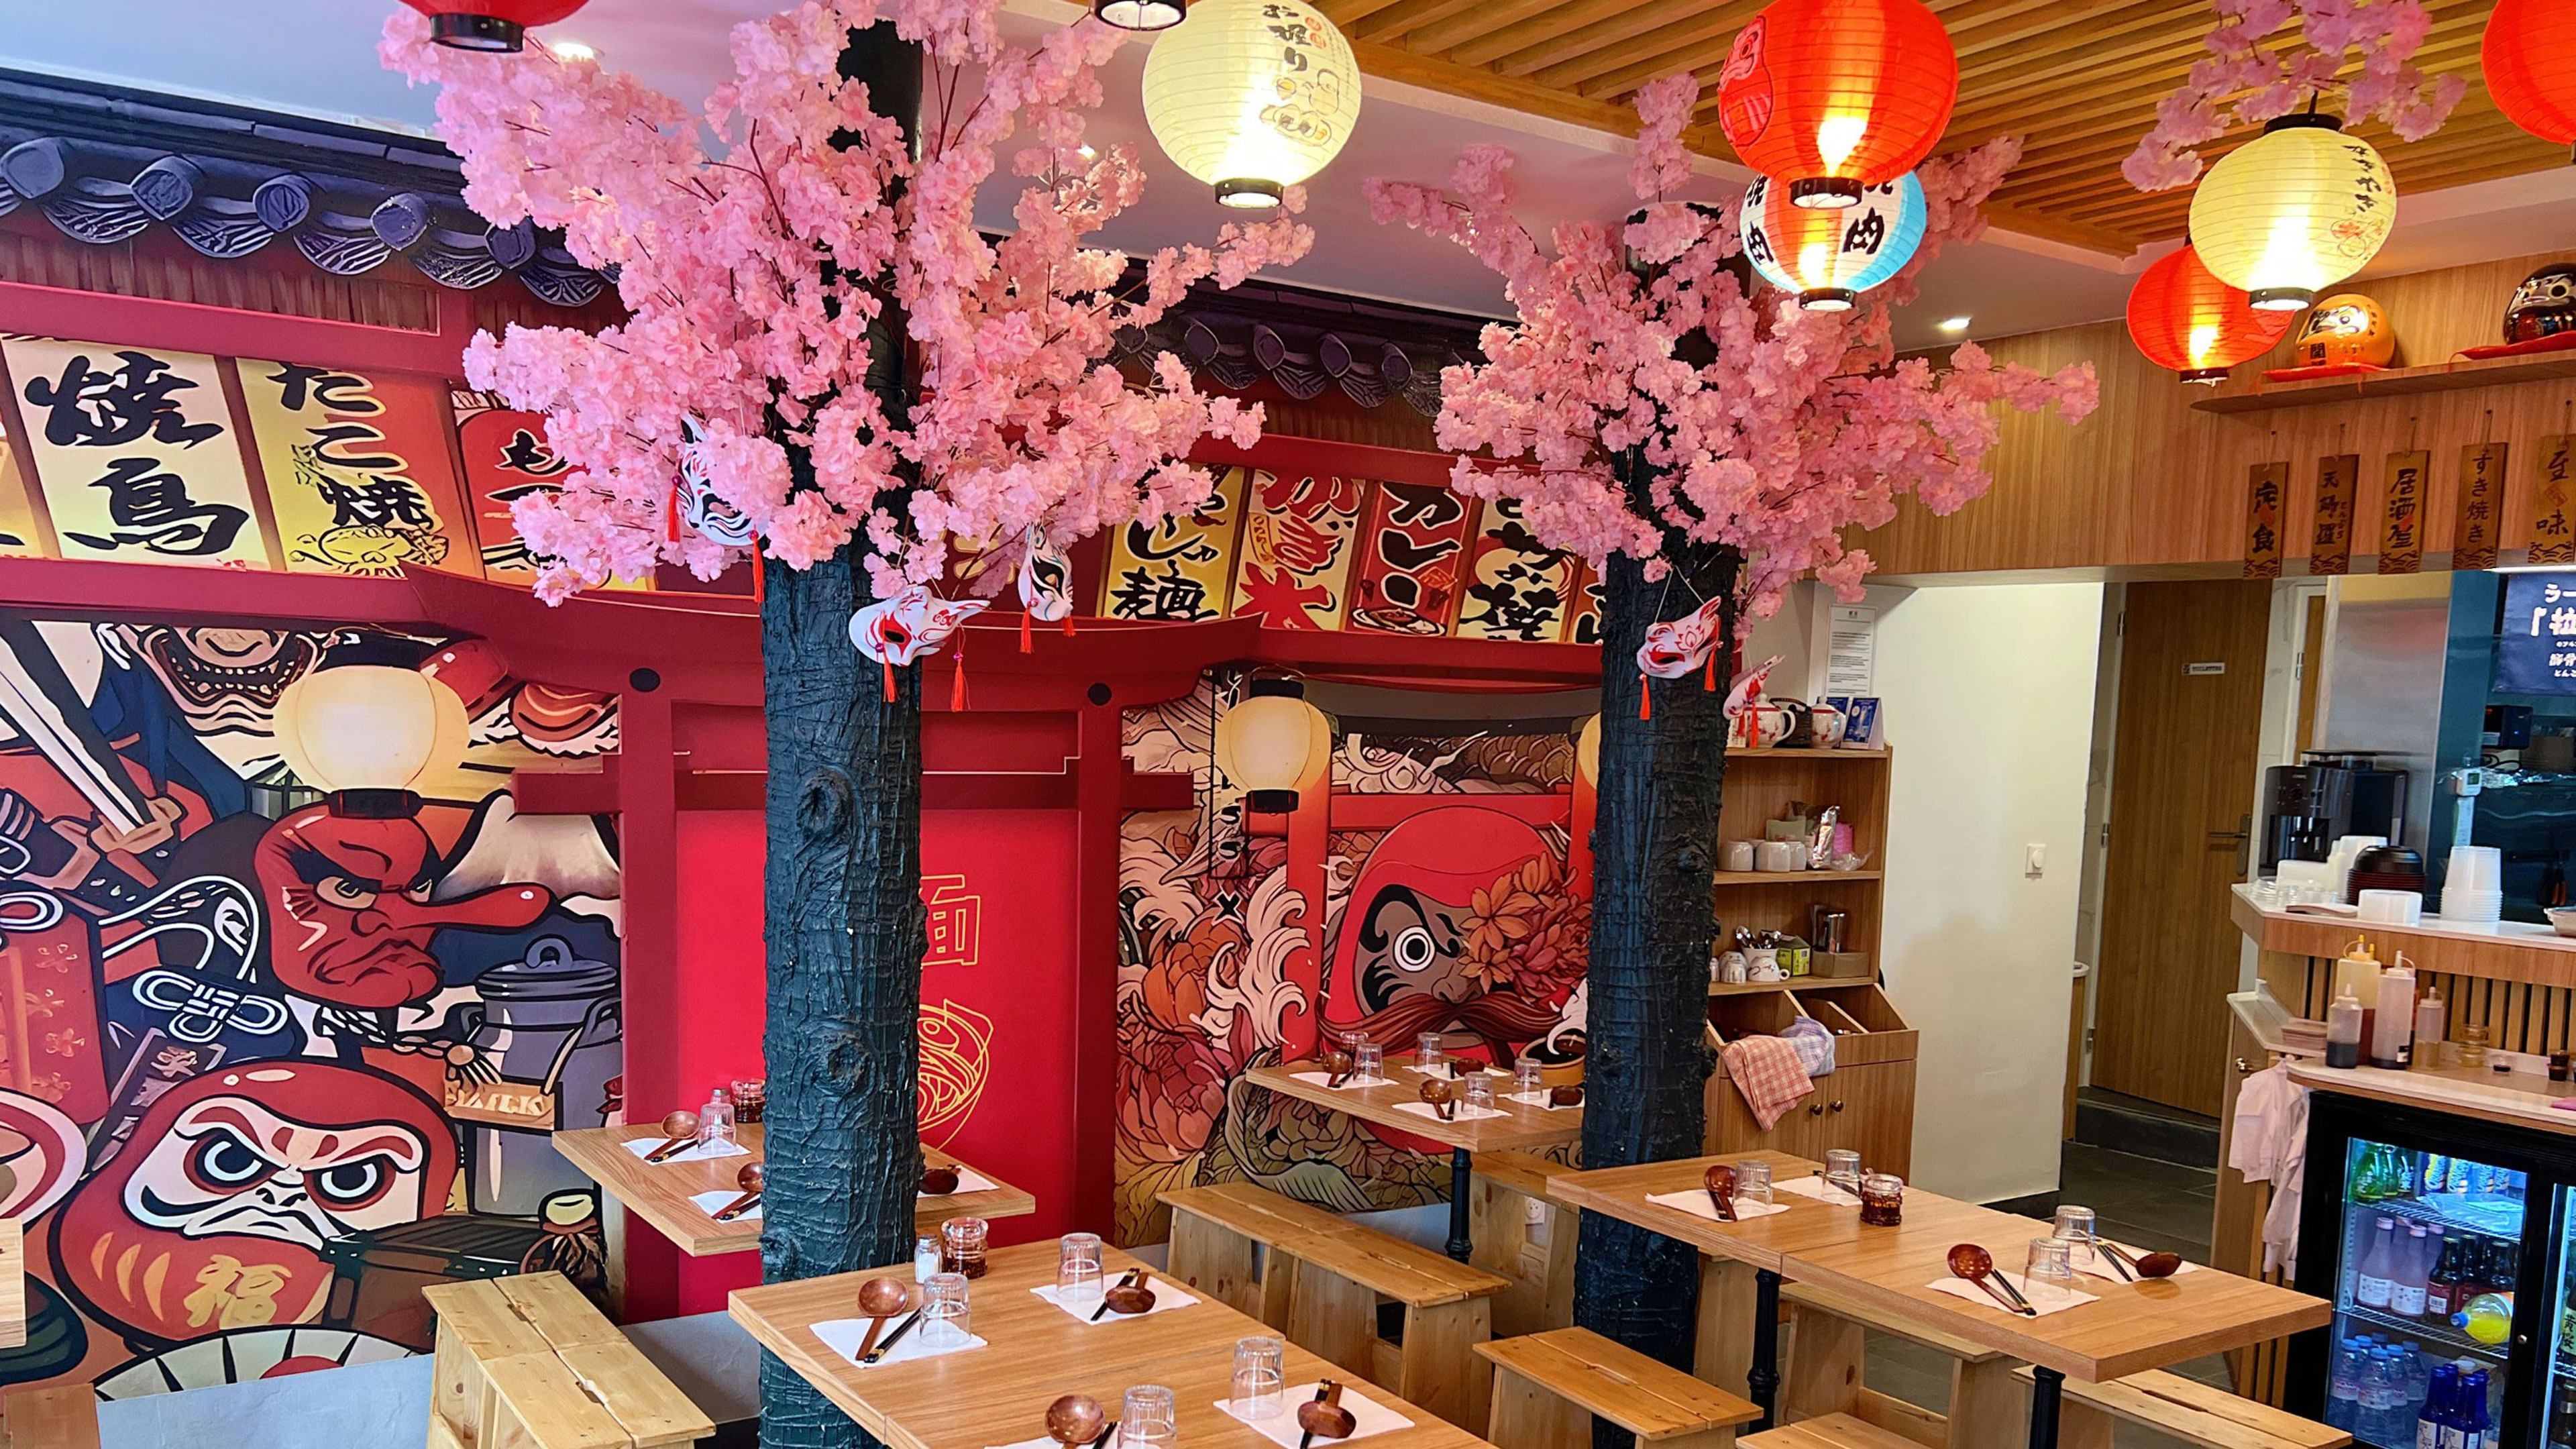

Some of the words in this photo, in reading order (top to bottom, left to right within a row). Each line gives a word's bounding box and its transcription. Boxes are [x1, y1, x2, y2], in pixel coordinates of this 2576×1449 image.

[24, 350, 250, 555] 焼鳥
[2387, 468, 2418, 549] 居酒屋
[2467, 453, 2493, 543] すき焼き
